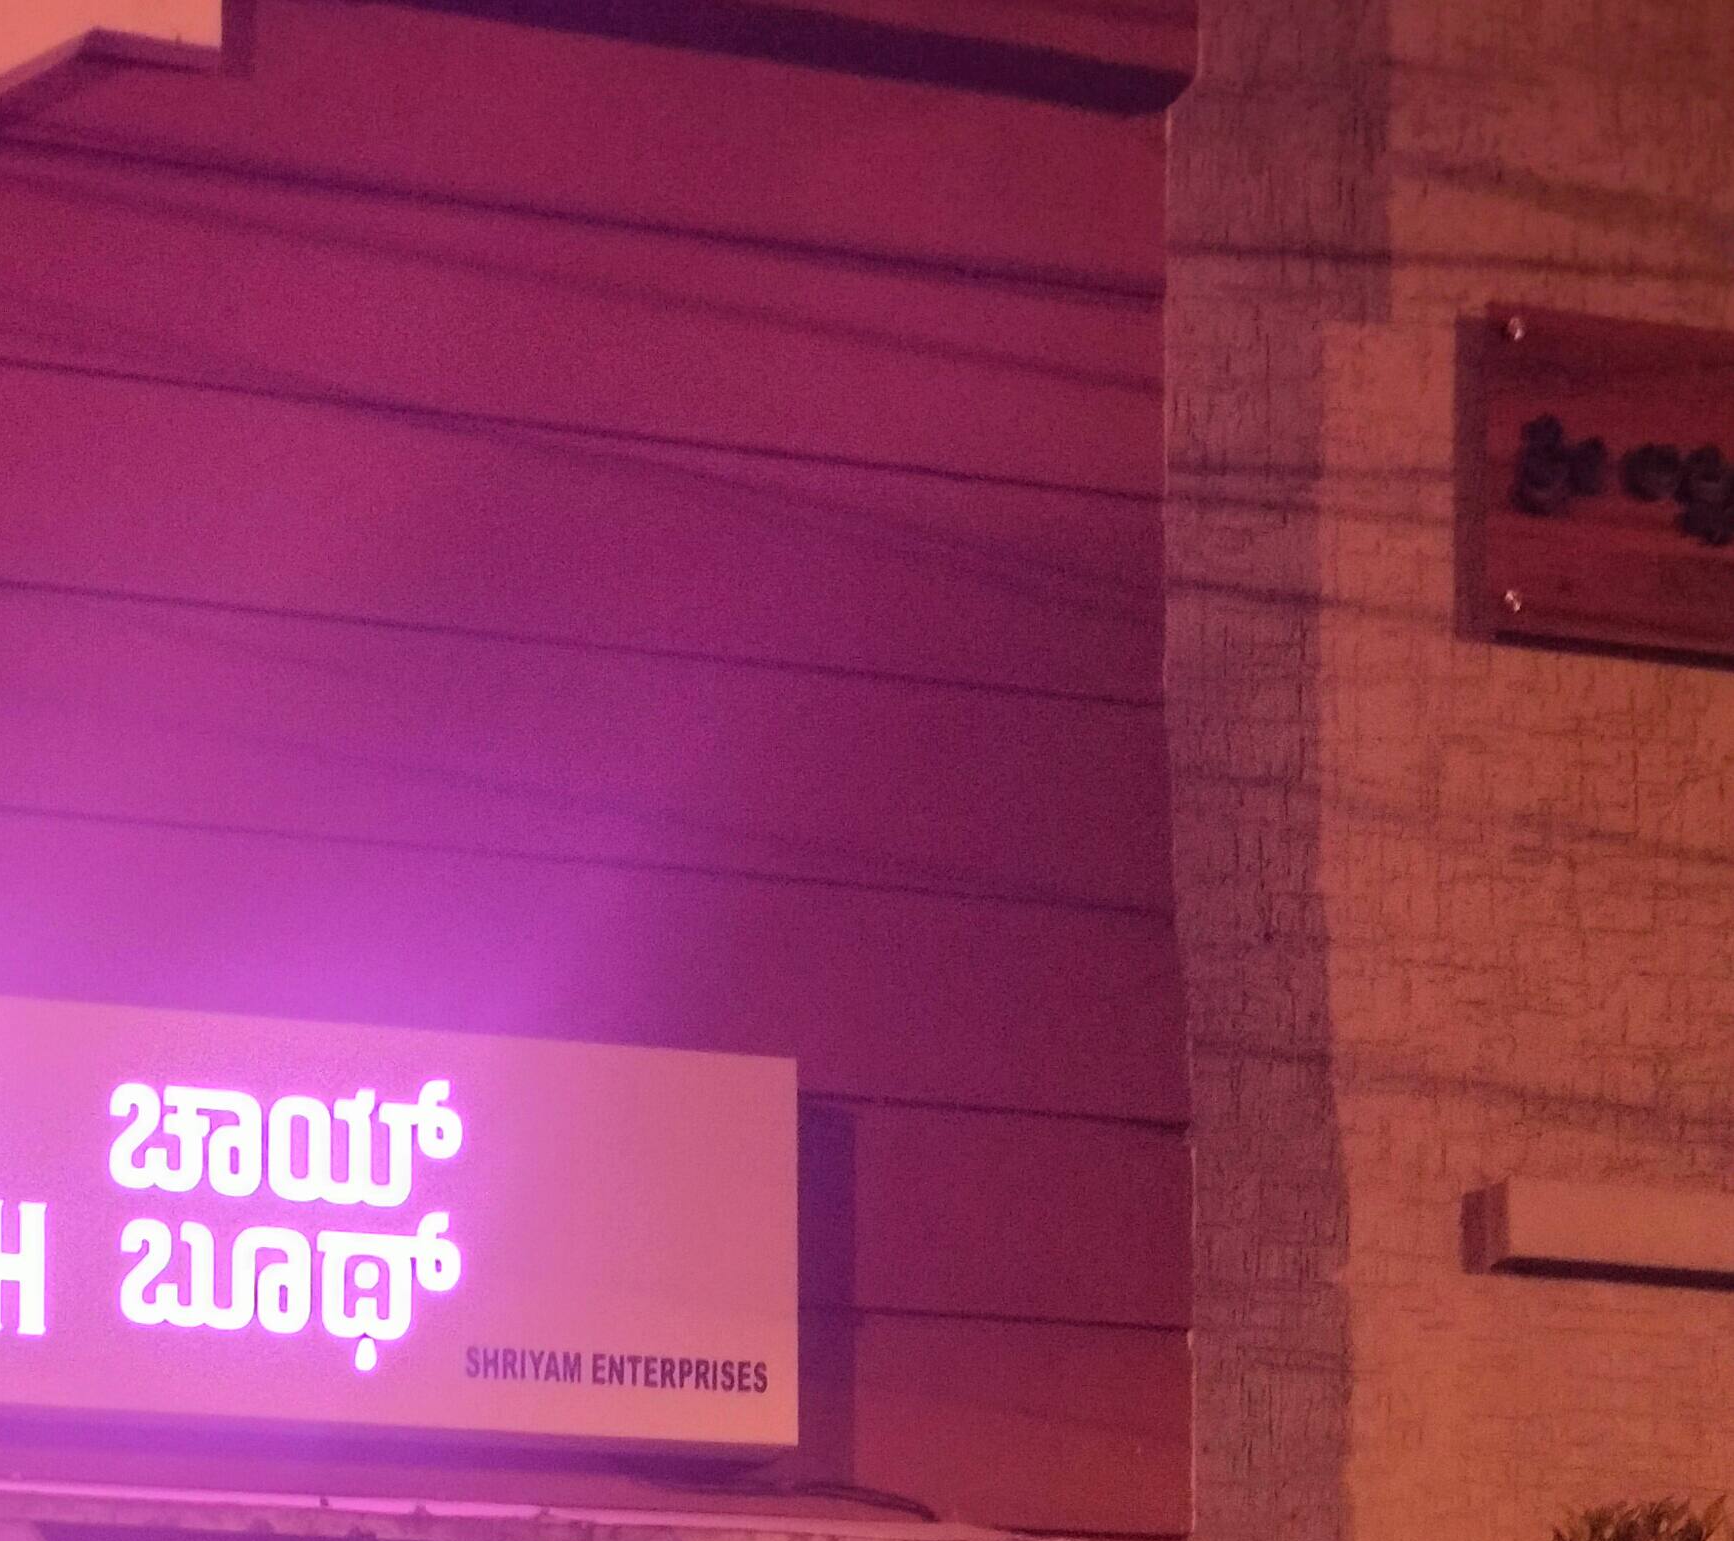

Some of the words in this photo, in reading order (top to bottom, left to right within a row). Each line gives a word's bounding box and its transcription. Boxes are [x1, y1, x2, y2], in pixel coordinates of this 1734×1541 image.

[108, 1079, 463, 1208] ಚಾಯ್
[119, 1210, 462, 1372] ಬೂಥ್
[465, 1346, 582, 1384] SHRIYAM
[591, 1352, 768, 1394] ENTERPRISES
